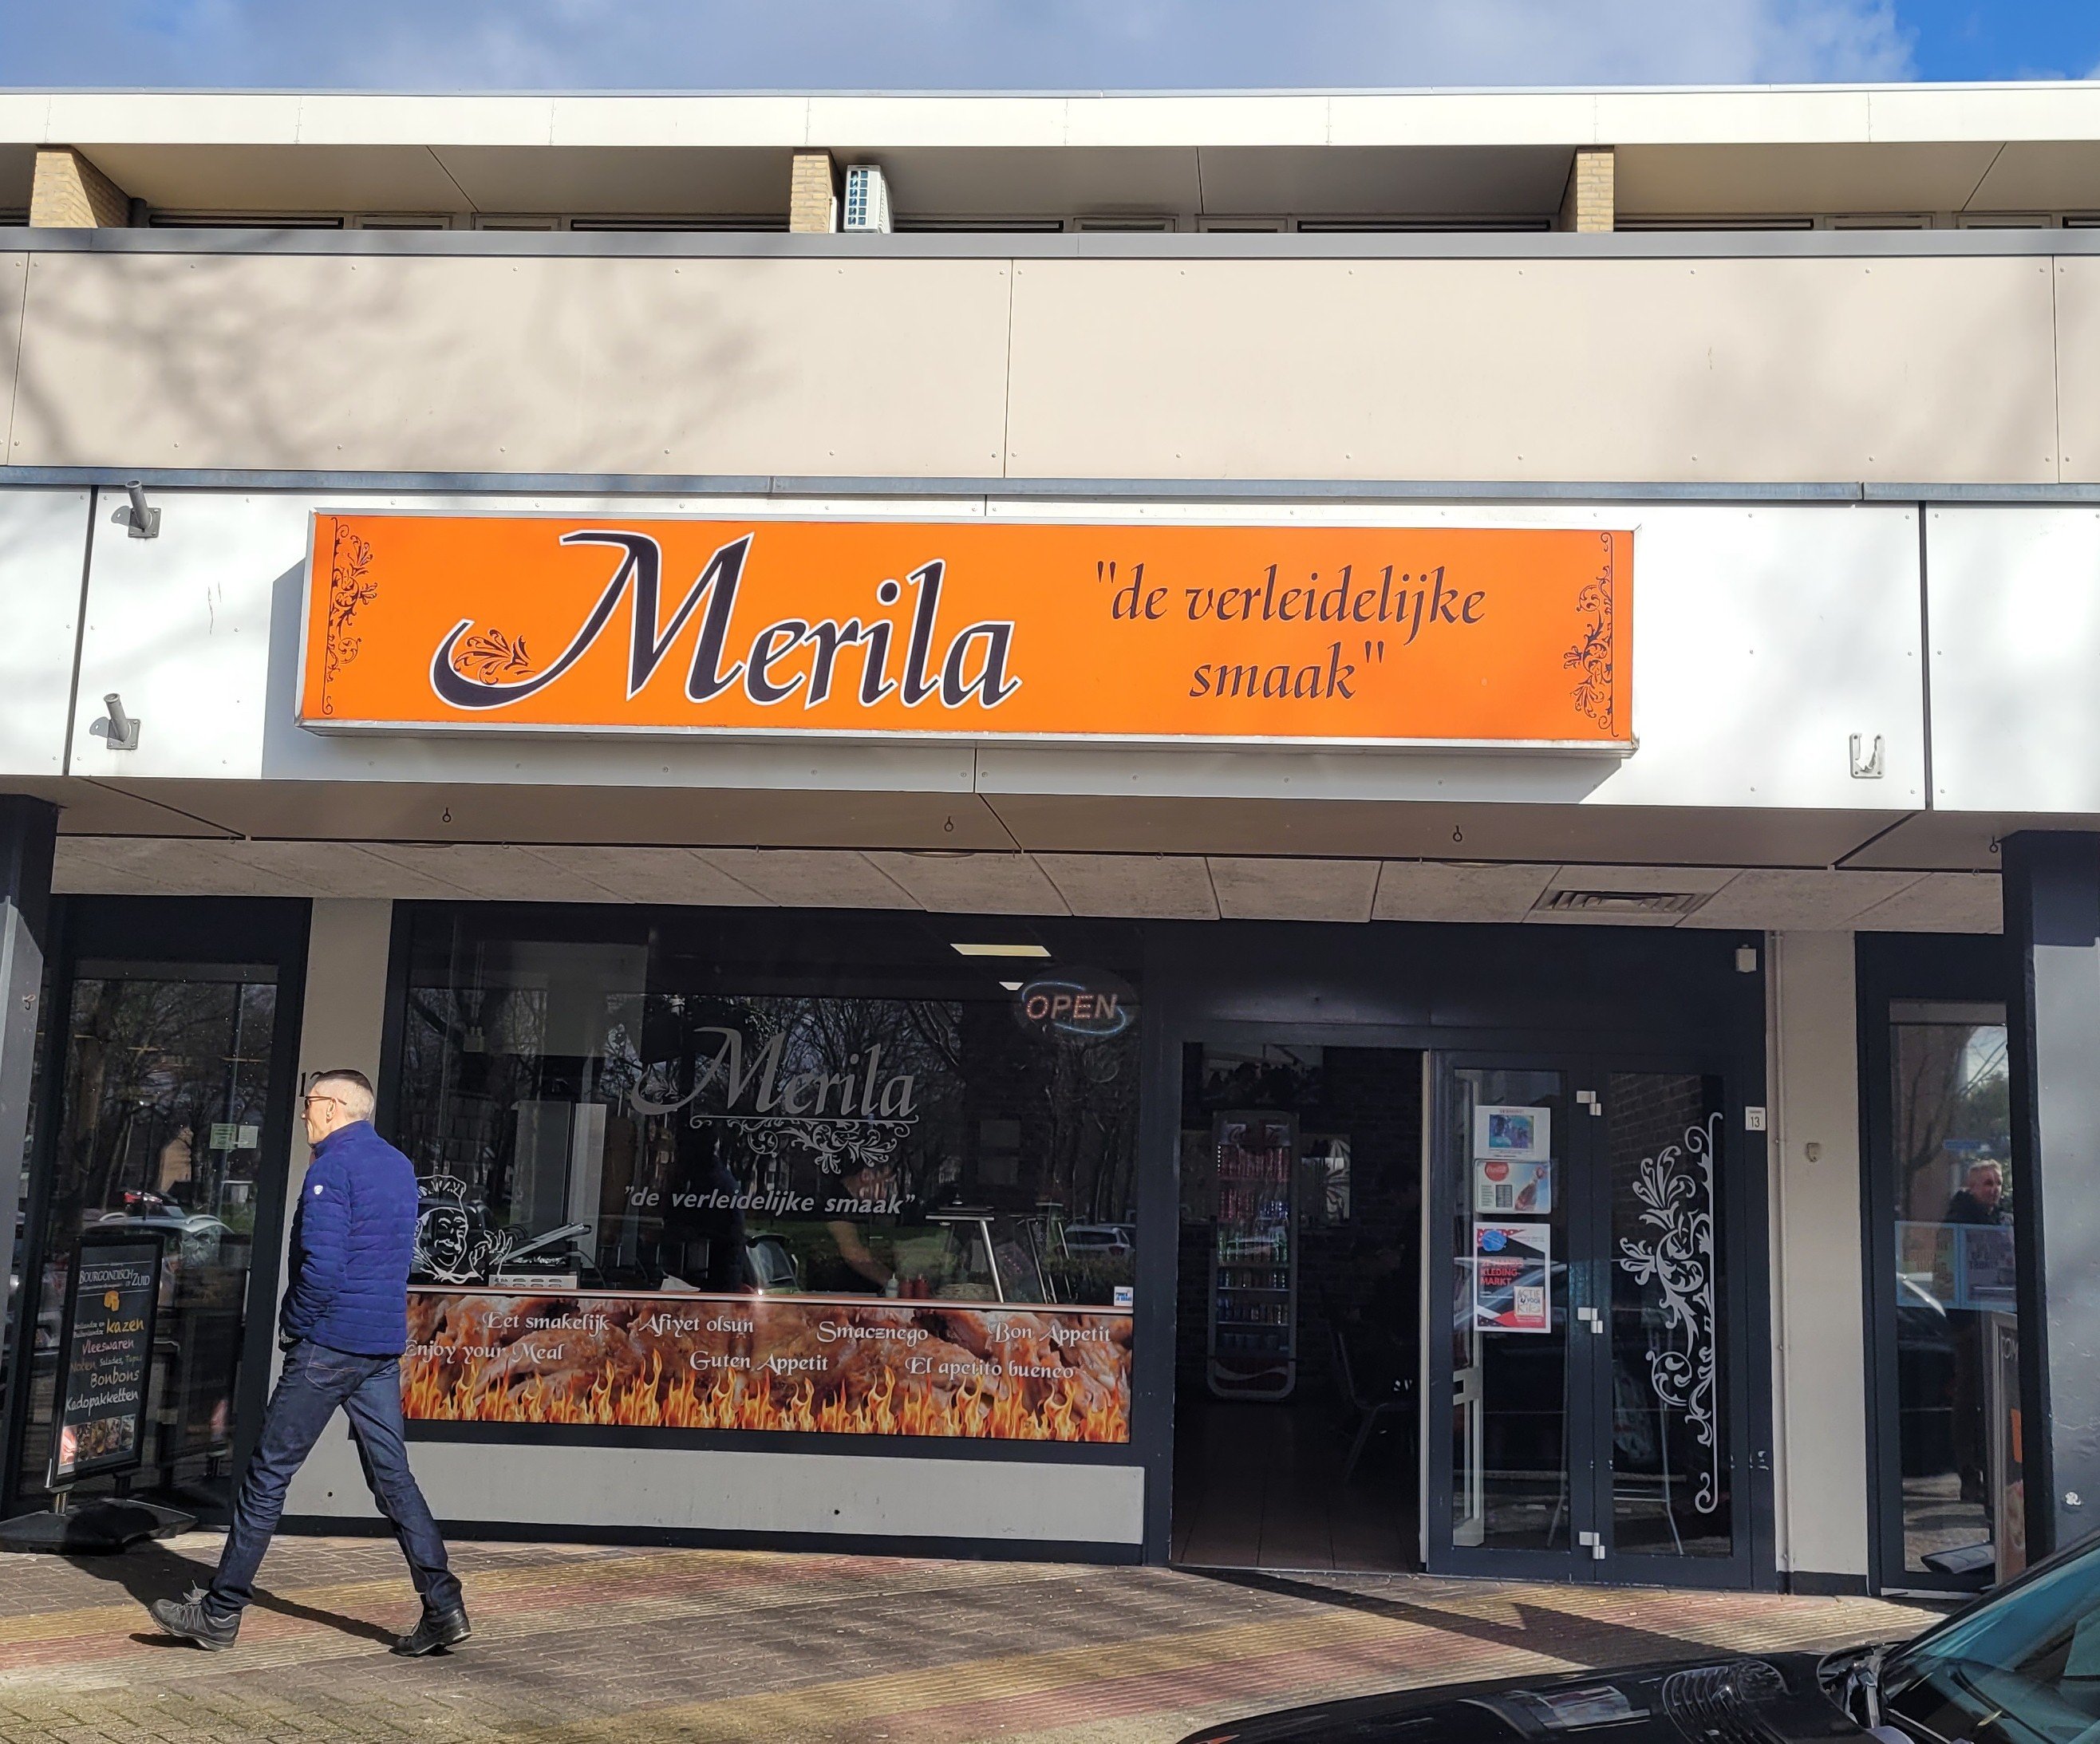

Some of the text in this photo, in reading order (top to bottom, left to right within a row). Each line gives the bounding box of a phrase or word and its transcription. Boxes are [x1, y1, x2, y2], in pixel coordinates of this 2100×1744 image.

[1096, 561, 1486, 645] "de verleidelijke
[429, 530, 1023, 710] Merila
[1189, 641, 1384, 700] smaak"
[1026, 994, 1117, 1020] OPEN
[630, 1027, 918, 1117] Merila
[1751, 1116, 1760, 1128] 13
[673, 1189, 815, 1217] verleidelijke
[1480, 1276, 1512, 1285] MARKT
[106, 1318, 144, 1333] kazen
[483, 1312, 610, 1337] Eet smakelijk
[638, 1313, 754, 1337] Afiyet olsun
[816, 1321, 929, 1347] Smacznego
[987, 1322, 1111, 1348] Bon Appetit
[82, 1339, 134, 1355] Vleeswaren
[403, 1340, 565, 1364] Enjoy your Meal
[689, 1350, 828, 1376] Guten Appetit
[905, 1357, 933, 1375] El
[938, 1359, 1002, 1381] apetito
[90, 1366, 140, 1388] Bonbons
